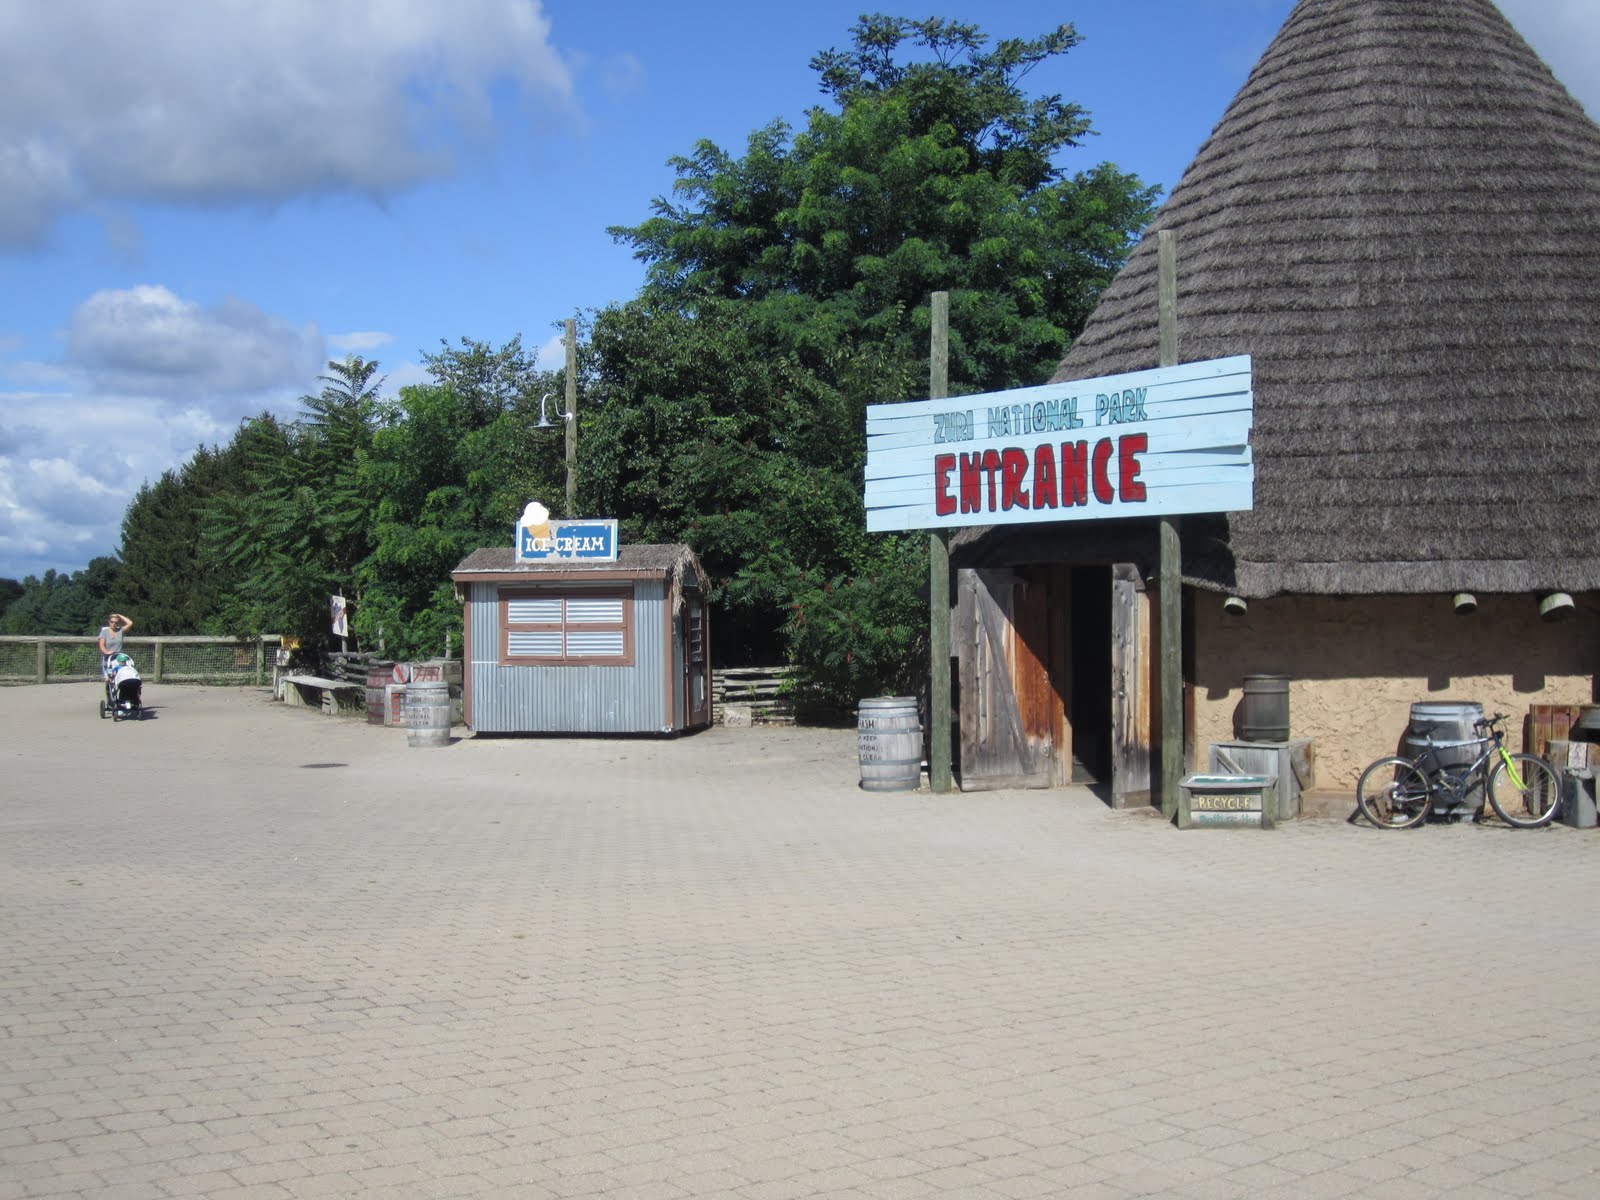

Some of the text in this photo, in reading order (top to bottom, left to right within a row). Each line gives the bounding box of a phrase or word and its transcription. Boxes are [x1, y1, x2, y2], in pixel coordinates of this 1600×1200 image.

[933, 387, 1148, 444] ZURI NATIONAL PARK
[934, 432, 1149, 517] ENTRANCE
[525, 536, 604, 552] ICE CREAM
[1198, 796, 1251, 810] RECYCLE
